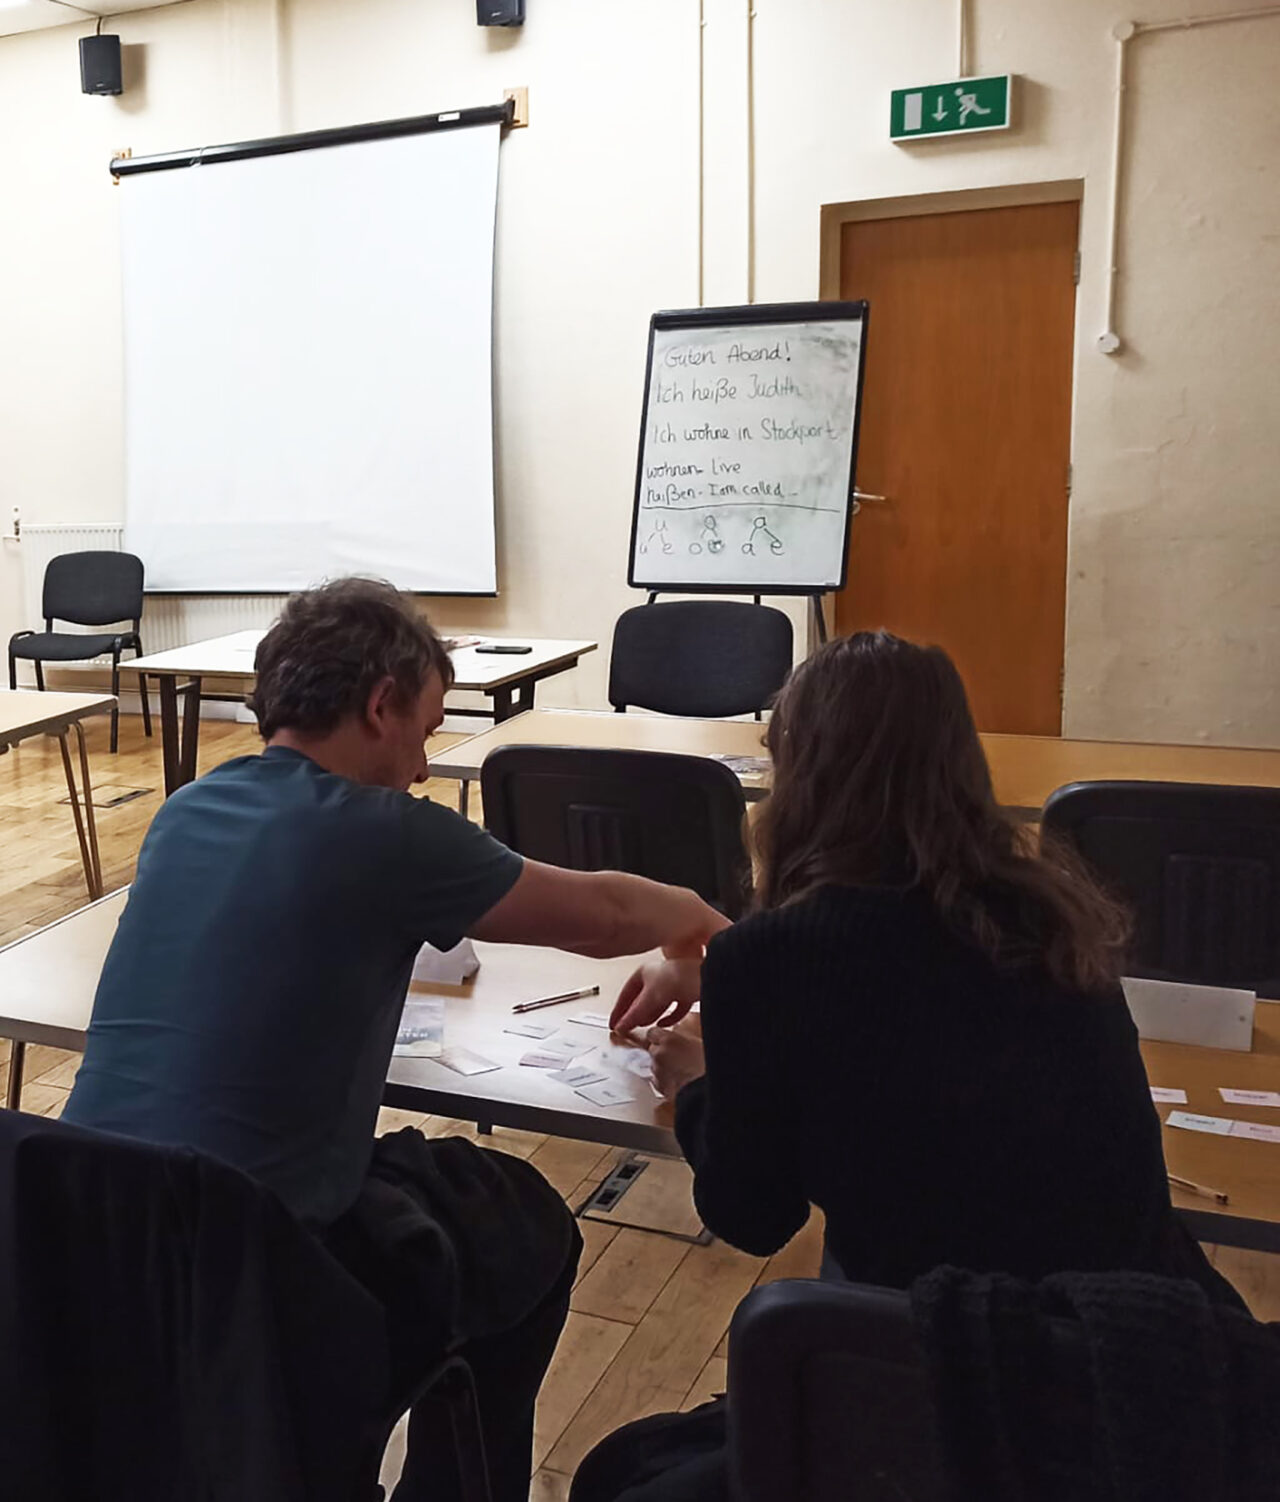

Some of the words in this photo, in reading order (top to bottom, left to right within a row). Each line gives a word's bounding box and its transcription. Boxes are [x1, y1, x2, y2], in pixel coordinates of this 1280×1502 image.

[664, 345, 716, 369] Guten
[727, 341, 792, 364] Abend!
[656, 381, 684, 404] Ich
[692, 377, 737, 405] heiße
[747, 373, 802, 399] Judith
[654, 422, 677, 444] Ich
[683, 422, 730, 442] wohne
[738, 427, 753, 441] in
[761, 417, 838, 446] Stockport
